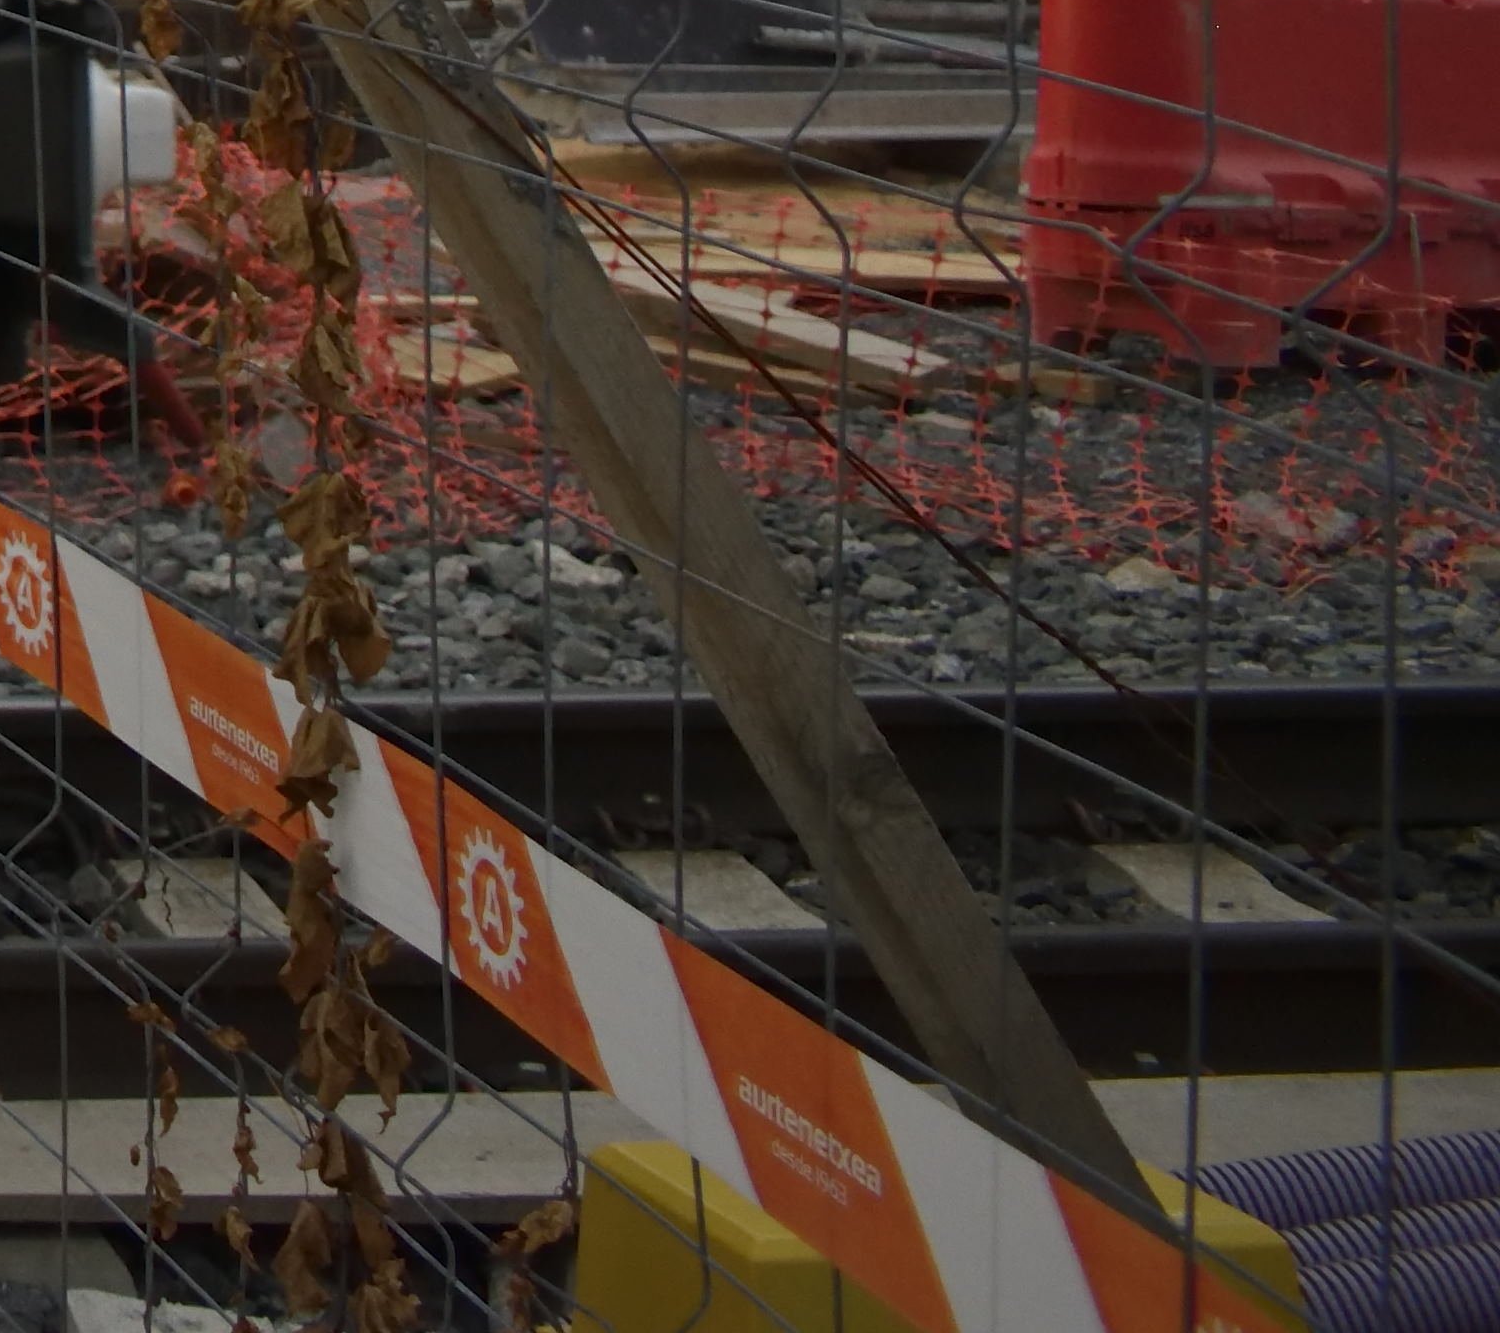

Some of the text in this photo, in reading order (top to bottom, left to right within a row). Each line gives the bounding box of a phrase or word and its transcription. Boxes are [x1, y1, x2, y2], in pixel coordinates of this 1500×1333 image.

[189, 695, 279, 774] aurtenetxea
[482, 878, 505, 944] A
[738, 1074, 882, 1198] aurtenetxea
[771, 1138, 848, 1206] desde 1963
